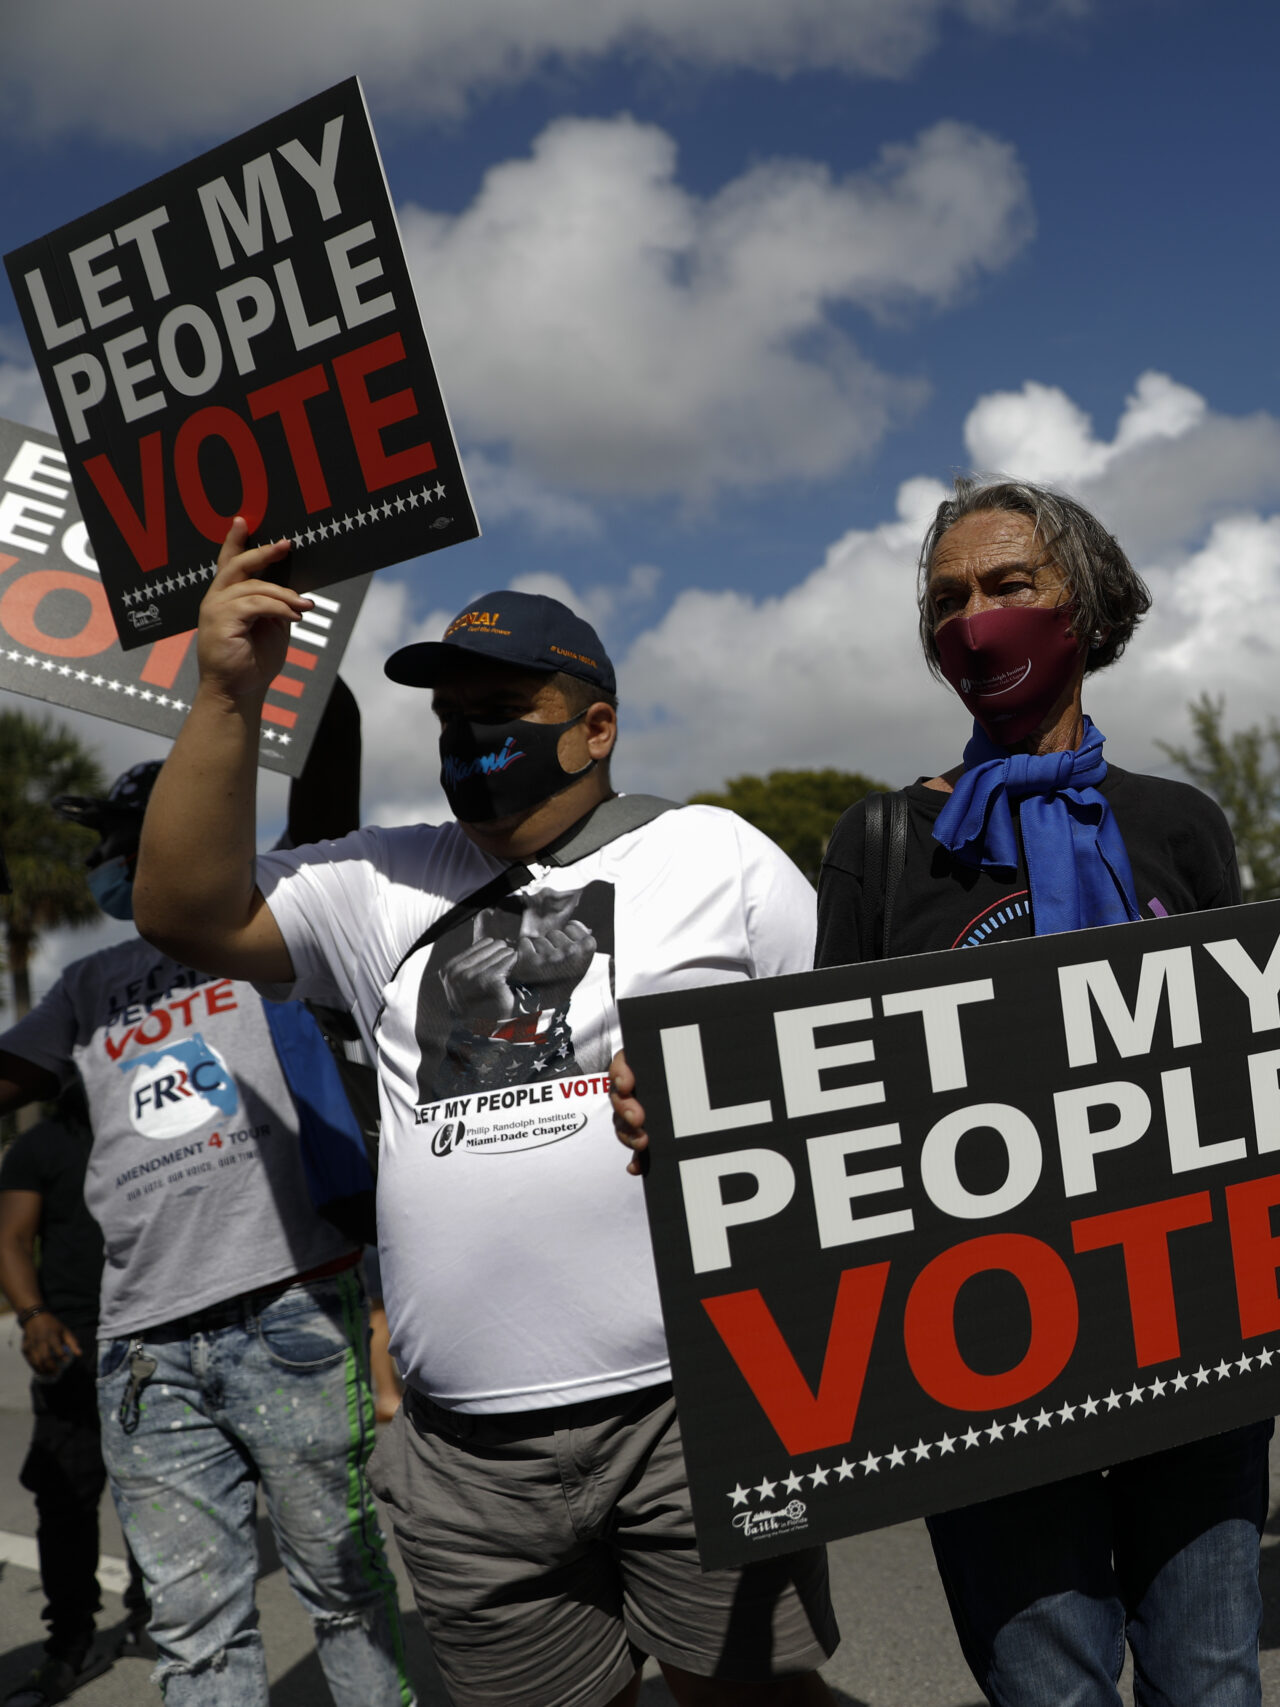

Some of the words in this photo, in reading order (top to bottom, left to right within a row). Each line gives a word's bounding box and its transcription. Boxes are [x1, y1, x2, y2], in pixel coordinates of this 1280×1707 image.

[25, 206, 171, 350] LET
[197, 115, 344, 270] MY
[53, 220, 396, 444] PEOPLE
[83, 332, 437, 573] VOTE
[104, 979, 238, 1061] VOTE
[659, 978, 995, 1138] LET
[414, 1106, 442, 1125] LET
[444, 1099, 471, 1119] MY
[476, 1085, 553, 1113] PEOPLE
[466, 1124, 490, 1137] Philip
[492, 1118, 535, 1132] Randolph
[538, 1112, 576, 1124] Institute
[466, 1129, 529, 1148] Miami-Dade
[532, 1122, 578, 1138] Chapter
[115, 1141, 205, 1189] AMENDMENT
[208, 1132, 223, 1149] 4
[227, 1124, 271, 1145] TOUR
[732, 1511, 779, 1537] Faith
